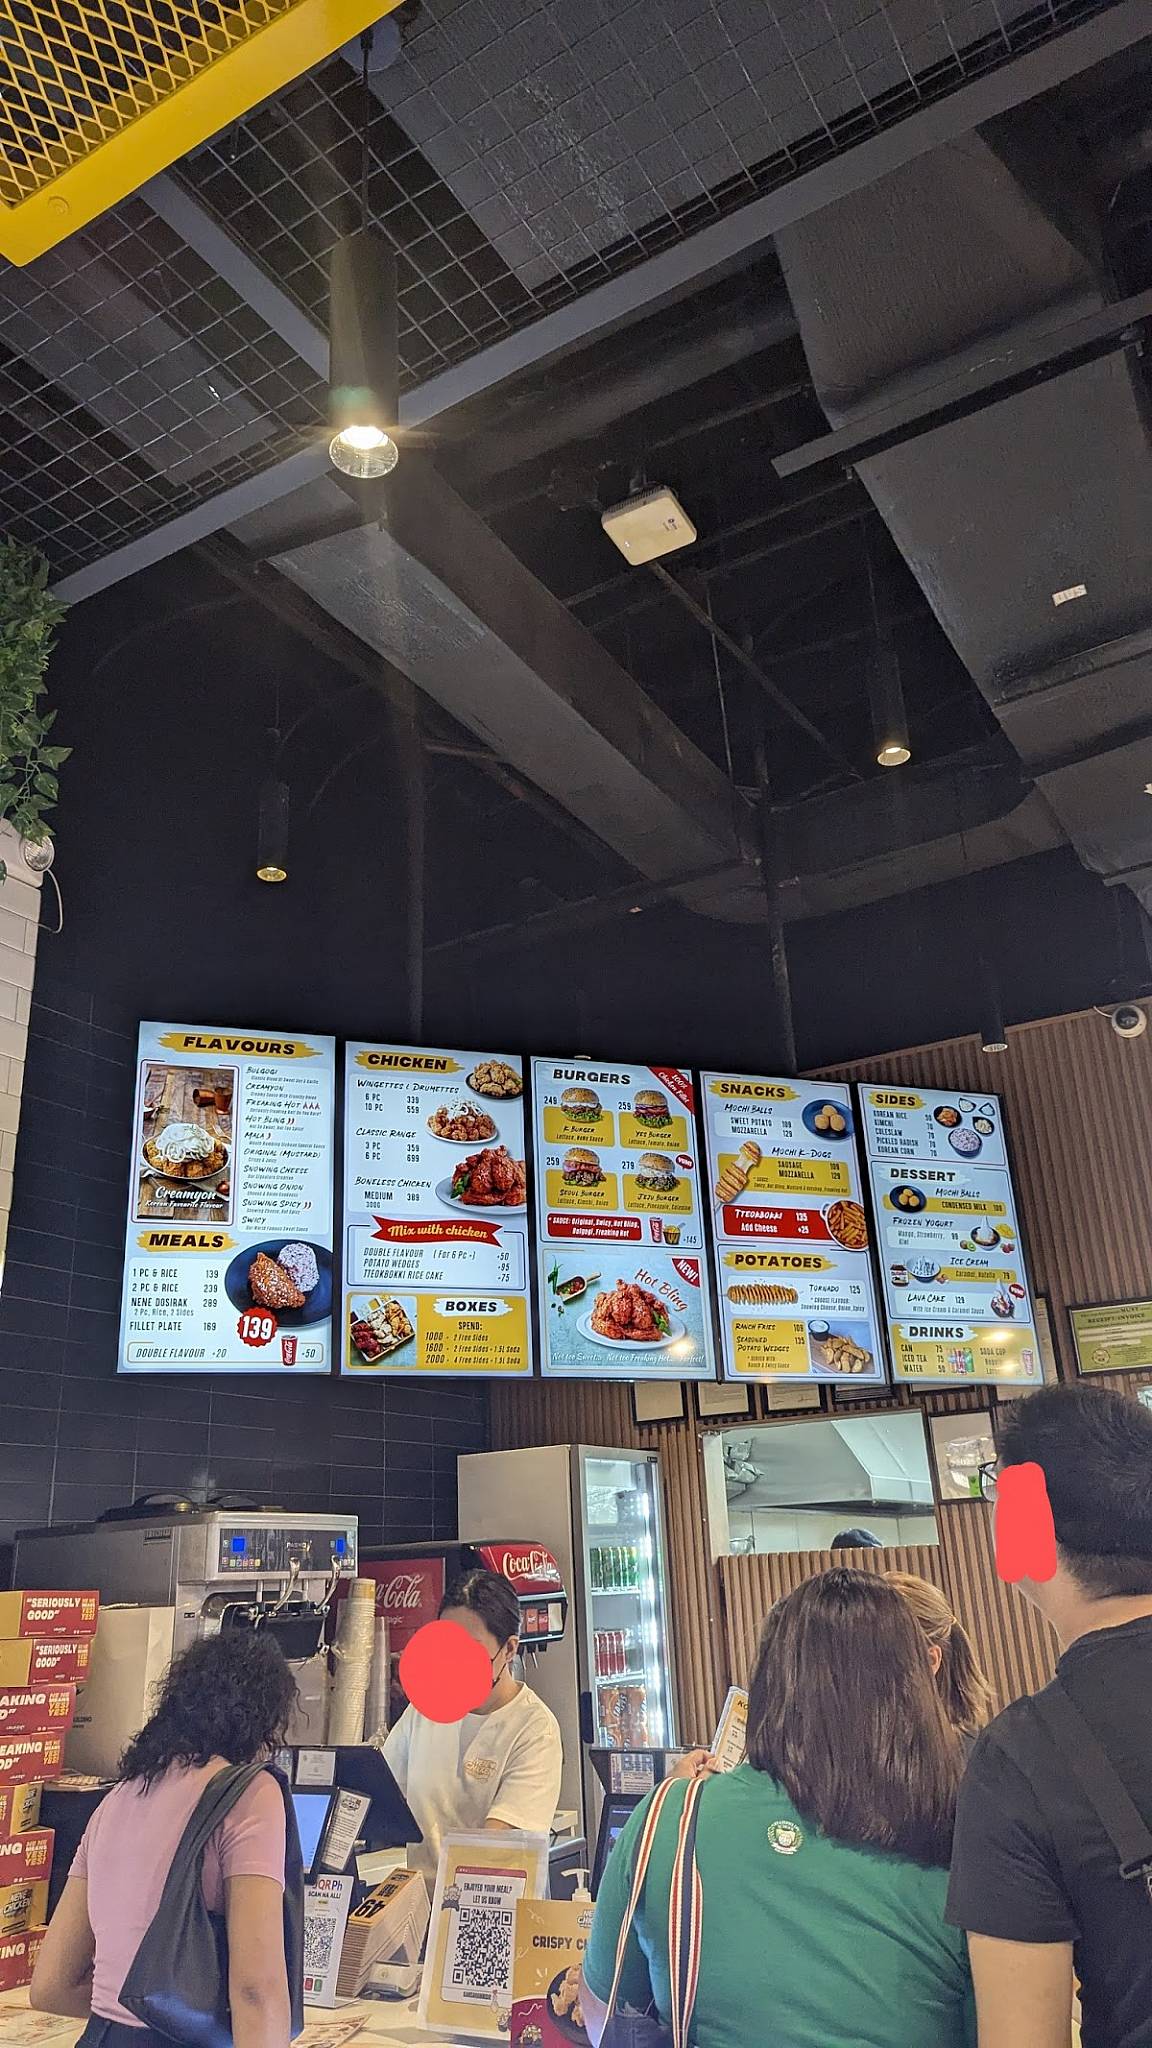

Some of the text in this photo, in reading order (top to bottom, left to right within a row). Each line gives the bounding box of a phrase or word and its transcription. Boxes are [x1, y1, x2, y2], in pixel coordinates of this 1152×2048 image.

[183, 1036, 295, 1055] FLAVOURS
[367, 1054, 448, 1071] CHICKEN
[245, 1066, 278, 1075] BULGOGI
[553, 1069, 632, 1085] BURGERS
[658, 1071, 678, 1092] Chicken
[245, 1083, 285, 1092] CREAMYON
[357, 1079, 460, 1094] WINGETTES DRUMETTES
[720, 1083, 786, 1098] SNACKS
[246, 1099, 301, 1109] FREAKING HOT
[543, 1095, 558, 1105] 249
[875, 1094, 916, 1107] SIDES
[365, 1102, 420, 1114] 10 PC 559
[618, 1101, 632, 1111] 259
[724, 1103, 773, 1115] MOCHI BALLS
[245, 1114, 285, 1124] HOT BLING
[730, 1117, 773, 1127] SWEET POTATO
[244, 1132, 265, 1140] MALA
[355, 1127, 417, 1139] CLASSIC RANGE
[731, 1126, 768, 1136] MOZZARELLA
[365, 1142, 420, 1152] 3 PC 359
[243, 1148, 321, 1159] ORIGINAL (MUSTARD)
[365, 1152, 420, 1163] 6 PC 699
[771, 1147, 832, 1159] MOCHI K-DOGS
[546, 1157, 560, 1166] 259
[621, 1160, 635, 1170] 279
[777, 1160, 803, 1169] SAUSAGE
[243, 1165, 309, 1174] SNOWING CHEESE
[778, 1170, 815, 1179] MOZZARELLA
[890, 1168, 956, 1182] DESSERT
[242, 1181, 304, 1191] SNOWING ONION
[354, 1176, 432, 1189] BONELESS CHICKEN
[155, 1186, 216, 1205] Creamyon
[364, 1191, 393, 1201] MEDIUM
[559, 1189, 605, 1198] SEOUL BURGER
[656, 1194, 680, 1202] BURGER
[935, 1188, 981, 1198] MOCHI BALLS
[242, 1198, 302, 1209] SNOWING SPICY
[941, 1201, 973, 1210] CONDENSED
[241, 1216, 266, 1224] SWICY
[892, 1216, 954, 1228] FROZEN YOGURT
[387, 1223, 488, 1240] Mix with chicken
[741, 1222, 778, 1233] Add Cheese
[149, 1234, 224, 1248] MEALS
[363, 1247, 424, 1258] DOUBLE FLAVOUR
[363, 1259, 420, 1269] POTATO WEDGES
[734, 1254, 822, 1269] POTATOES
[950, 1257, 989, 1267] ICE CREAM
[139, 1268, 219, 1279] PC RICE 139
[363, 1269, 444, 1281] TTEOKBOKKI RICE CAKE
[677, 1259, 699, 1282] NEW!
[132, 1283, 218, 1293] 2 PC RICE 239
[634, 1268, 689, 1312] Hot Bling
[808, 1284, 861, 1294] TORNADO 125
[131, 1297, 153, 1307] NENE
[155, 1298, 188, 1307] DOSIRAK
[907, 1293, 946, 1303] LAVA CAKE
[445, 1301, 498, 1313] BOXES
[129, 1321, 217, 1331] FILLET PLATE 169
[242, 1315, 273, 1340] 139
[458, 1321, 483, 1331] SPEND:
[735, 1322, 776, 1331] RANCH FRIES
[425, 1332, 444, 1341] 1000
[909, 1326, 964, 1338] DRINKS
[736, 1335, 768, 1343] SEASONED
[136, 1348, 206, 1358] DOUBLE FLAVOUR
[737, 1344, 790, 1353] POTATO WEDGES
[900, 1344, 913, 1352] CAN
[425, 1354, 446, 1364] 2000
[901, 1355, 928, 1363] ICED TEA
[903, 1365, 923, 1373] WATER
[26, 1597, 81, 1608] "SERIOUSLY
[27, 1609, 61, 1621] GOOD"
[35, 1643, 78, 1656] "SERIOUSLY
[35, 1657, 61, 1669] GOOD"
[532, 1935, 573, 1950] CRISPY
